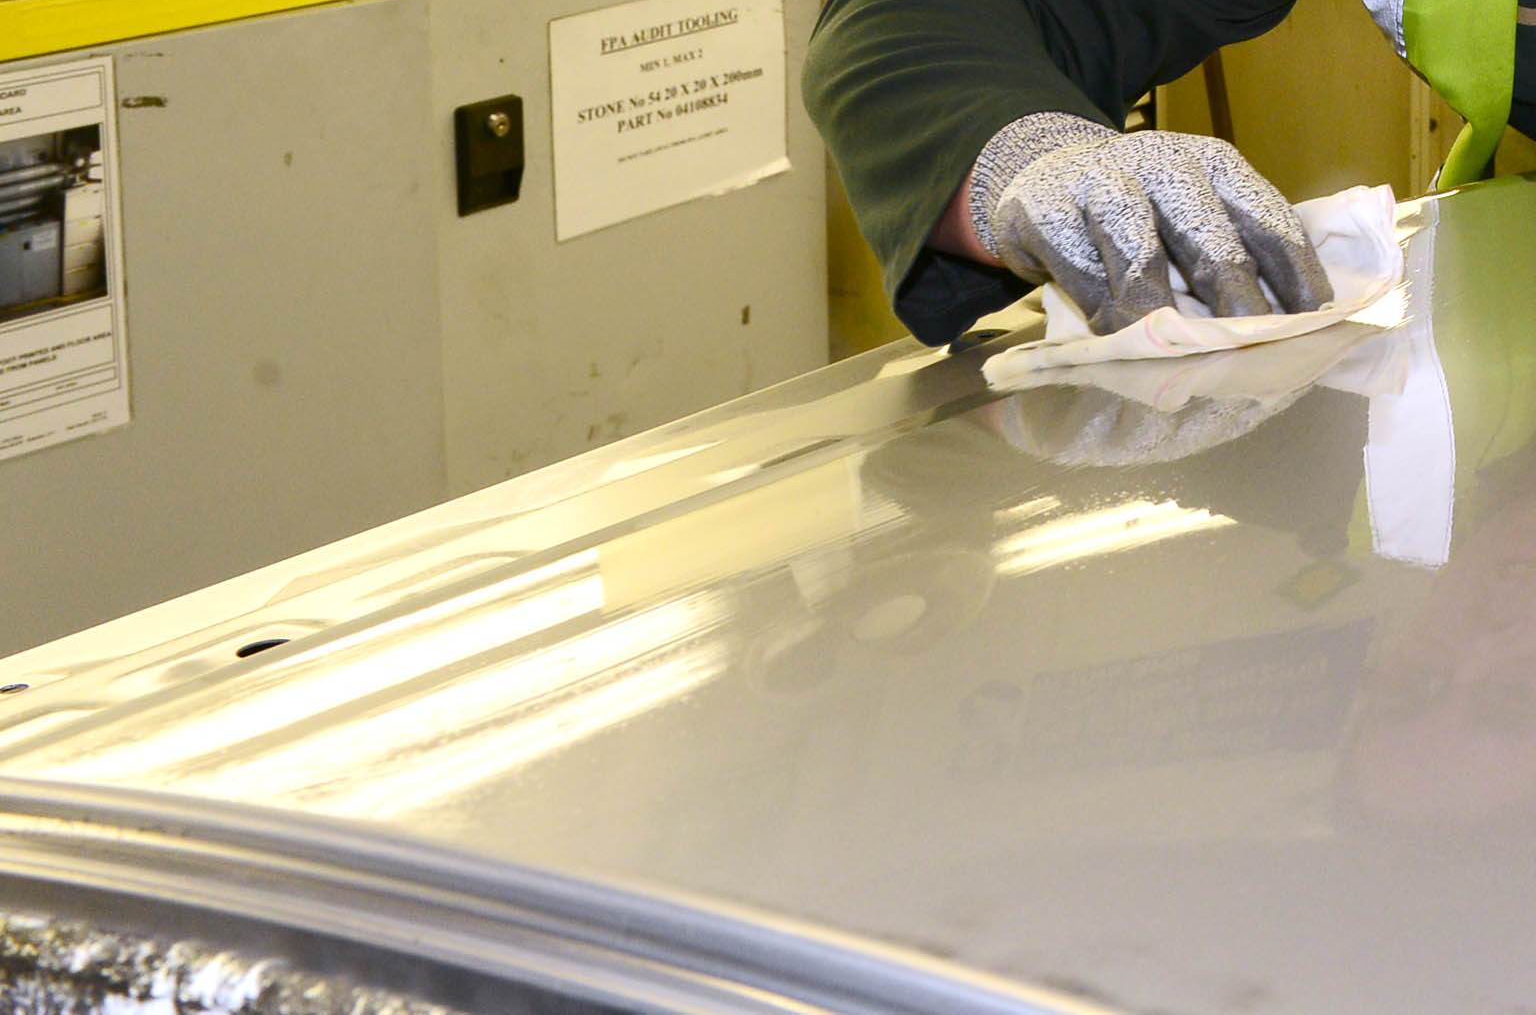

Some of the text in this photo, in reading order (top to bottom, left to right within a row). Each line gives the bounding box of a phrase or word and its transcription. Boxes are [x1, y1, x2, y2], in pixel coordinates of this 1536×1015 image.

[600, 8, 738, 52] FPA AUDIT TOOLING
[640, 60, 661, 73] MIN
[673, 51, 696, 64] MAX
[577, 68, 764, 124] STONE No 54 20 X 20 X 200mm
[617, 112, 653, 133] PART
[657, 109, 673, 121] No
